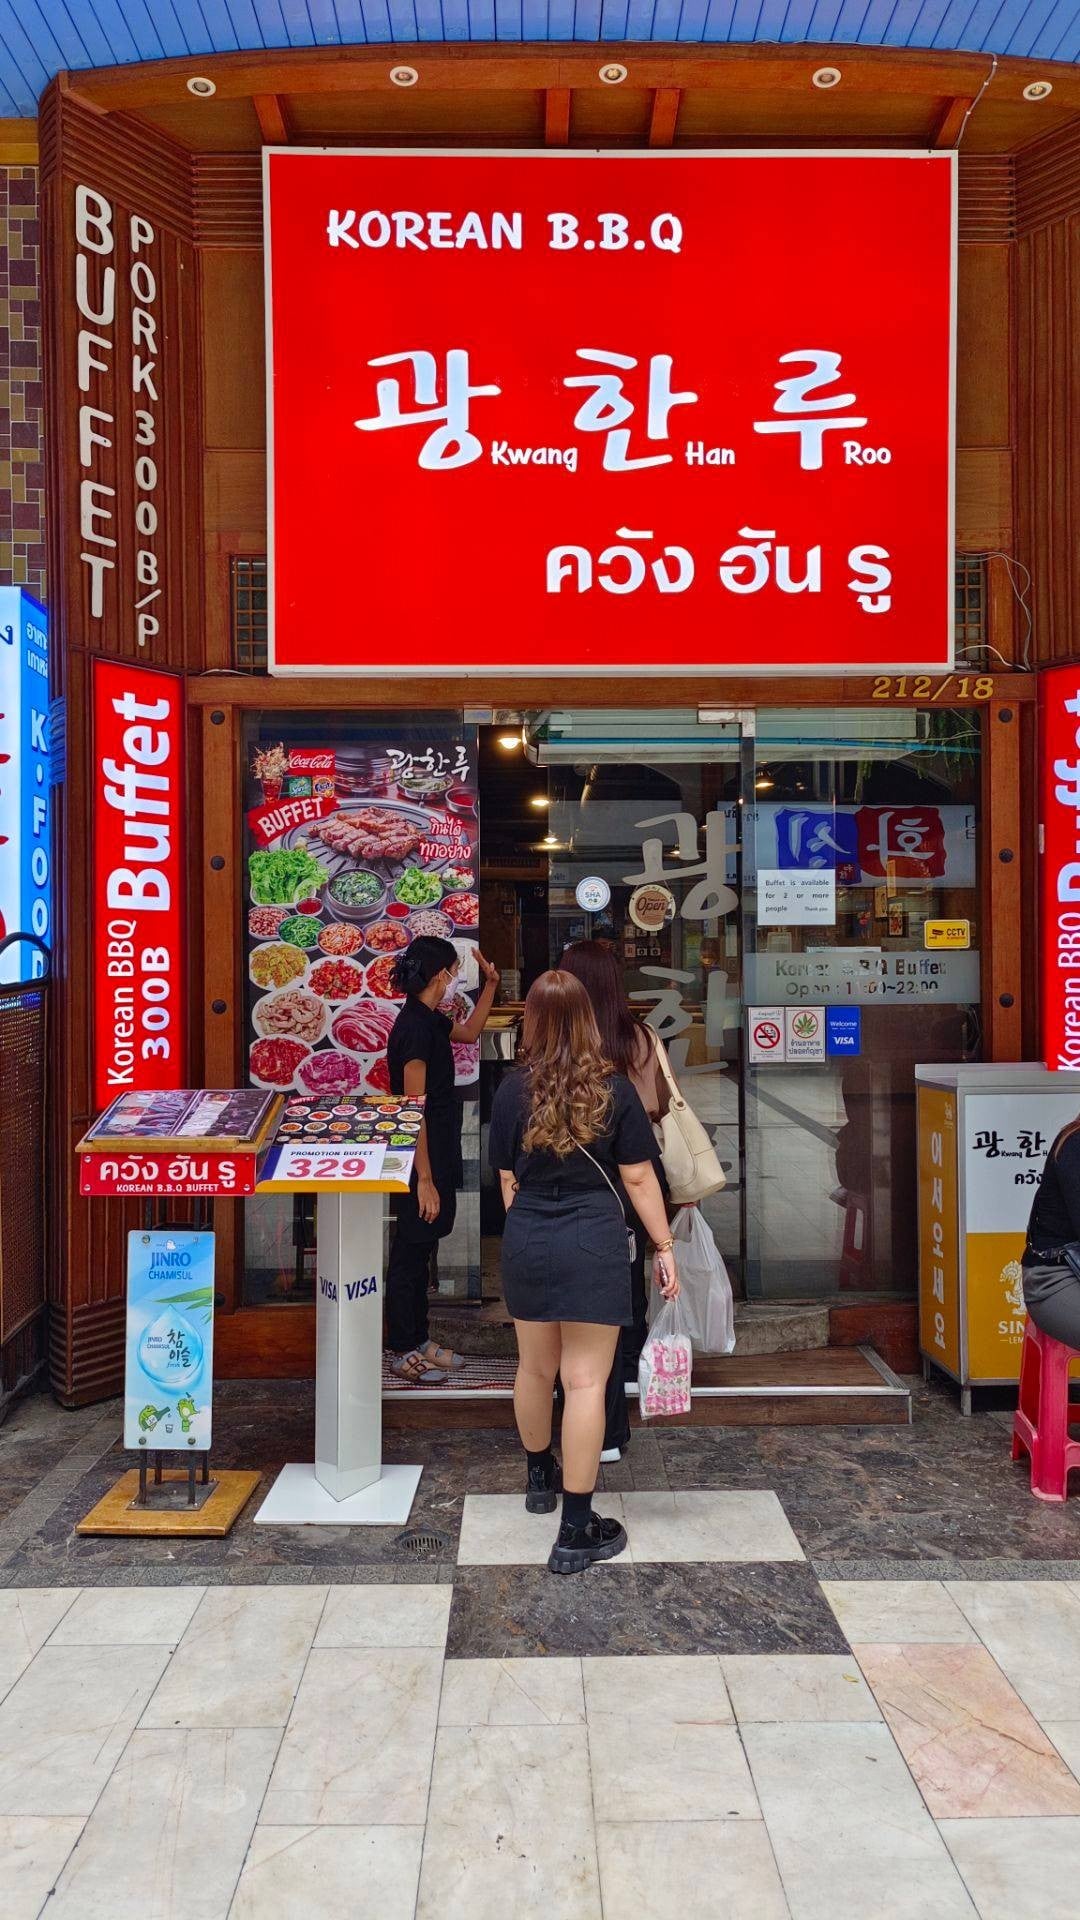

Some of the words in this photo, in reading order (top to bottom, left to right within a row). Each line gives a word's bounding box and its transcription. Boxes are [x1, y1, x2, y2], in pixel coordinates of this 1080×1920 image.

[327, 209, 522, 252] KOREAN
[547, 212, 684, 254] B.B.Q
[130, 215, 158, 401] PORK
[75, 184, 116, 618] BUFFET
[354, 348, 501, 471] 광
[563, 347, 698, 472] 한
[753, 349, 868, 471] 루
[491, 441, 578, 473] Kwang
[685, 441, 736, 466] Han
[844, 441, 891, 466] Roo
[546, 526, 695, 595] ควัง
[719, 526, 821, 595] ฮัน
[847, 543, 892, 614] รู
[872, 675, 994, 701] 212/18
[386, 746, 470, 782] 광한루
[102, 692, 171, 911] Buffet
[257, 797, 323, 838] BUFFET
[765, 879, 786, 887] Buffet
[636, 897, 666, 915] Open
[765, 905, 788, 913] people
[946, 928, 966, 937] CCTV
[107, 919, 138, 978] BBQ
[141, 946, 171, 1060] 300B
[107, 987, 135, 1085] Korean
[833, 1036, 855, 1045] VISA
[972, 1131, 1004, 1158] 광
[1016, 1130, 1046, 1158] 한
[1001, 1150, 1023, 1158] Kwang
[100, 1154, 159, 1181] ควัง
[168, 1154, 208, 1181] ฮัน
[218, 1160, 236, 1189] รู
[287, 1158, 366, 1178] 329
[116, 1184, 153, 1193] KOREAN
[157, 1184, 183, 1193] B.B.Q
[186, 1183, 219, 1192] BUFFET
[150, 1252, 192, 1270] JINRO
[148, 1271, 193, 1280] CHAMISUL
[344, 1276, 378, 1301] VISA
[319, 1276, 338, 1303] VISA
[998, 1320, 1026, 1335] SIN
